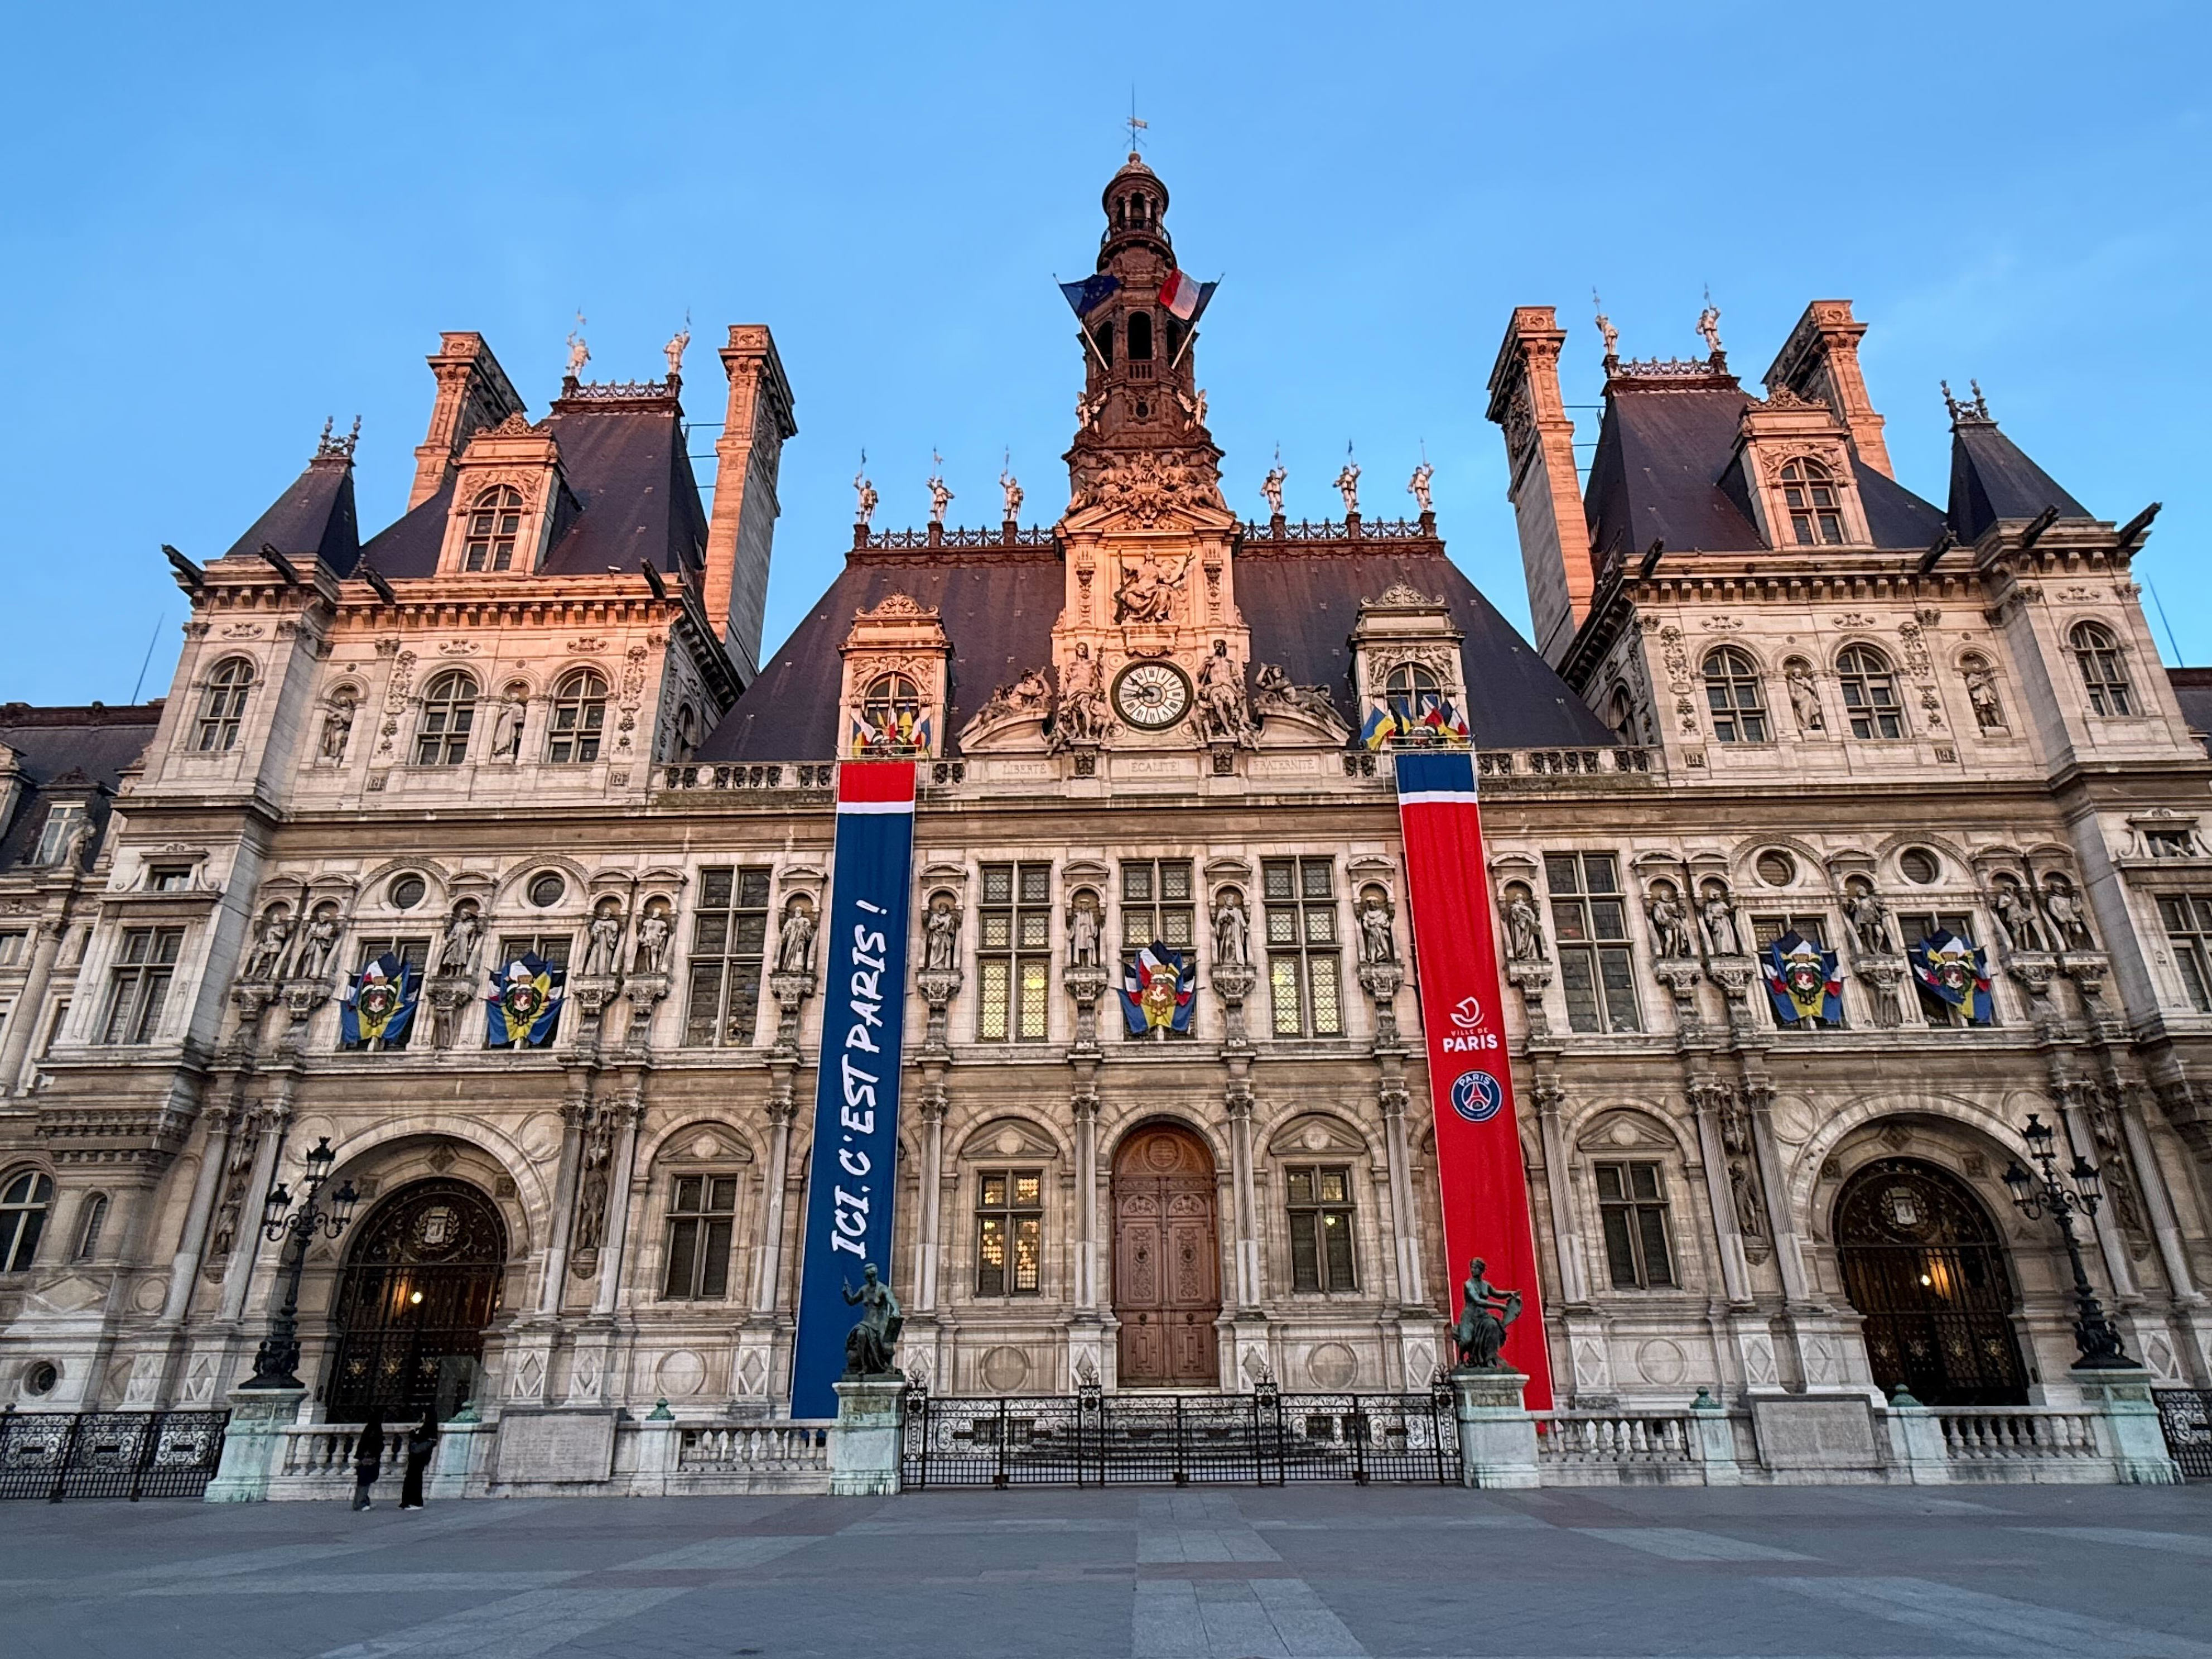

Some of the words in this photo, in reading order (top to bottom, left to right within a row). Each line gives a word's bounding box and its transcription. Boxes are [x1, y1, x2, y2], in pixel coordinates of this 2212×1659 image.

[1003, 763, 1047, 774] LIBERTÉ
[1252, 758, 1314, 771] FRATERNITÉ
[845, 924, 886, 1053] PARIS
[1450, 1029, 1474, 1037] VILLE
[1443, 1034, 1498, 1053] PARIS
[1458, 1074, 1491, 1087] PARIS
[838, 1053, 879, 1175] C'EST
